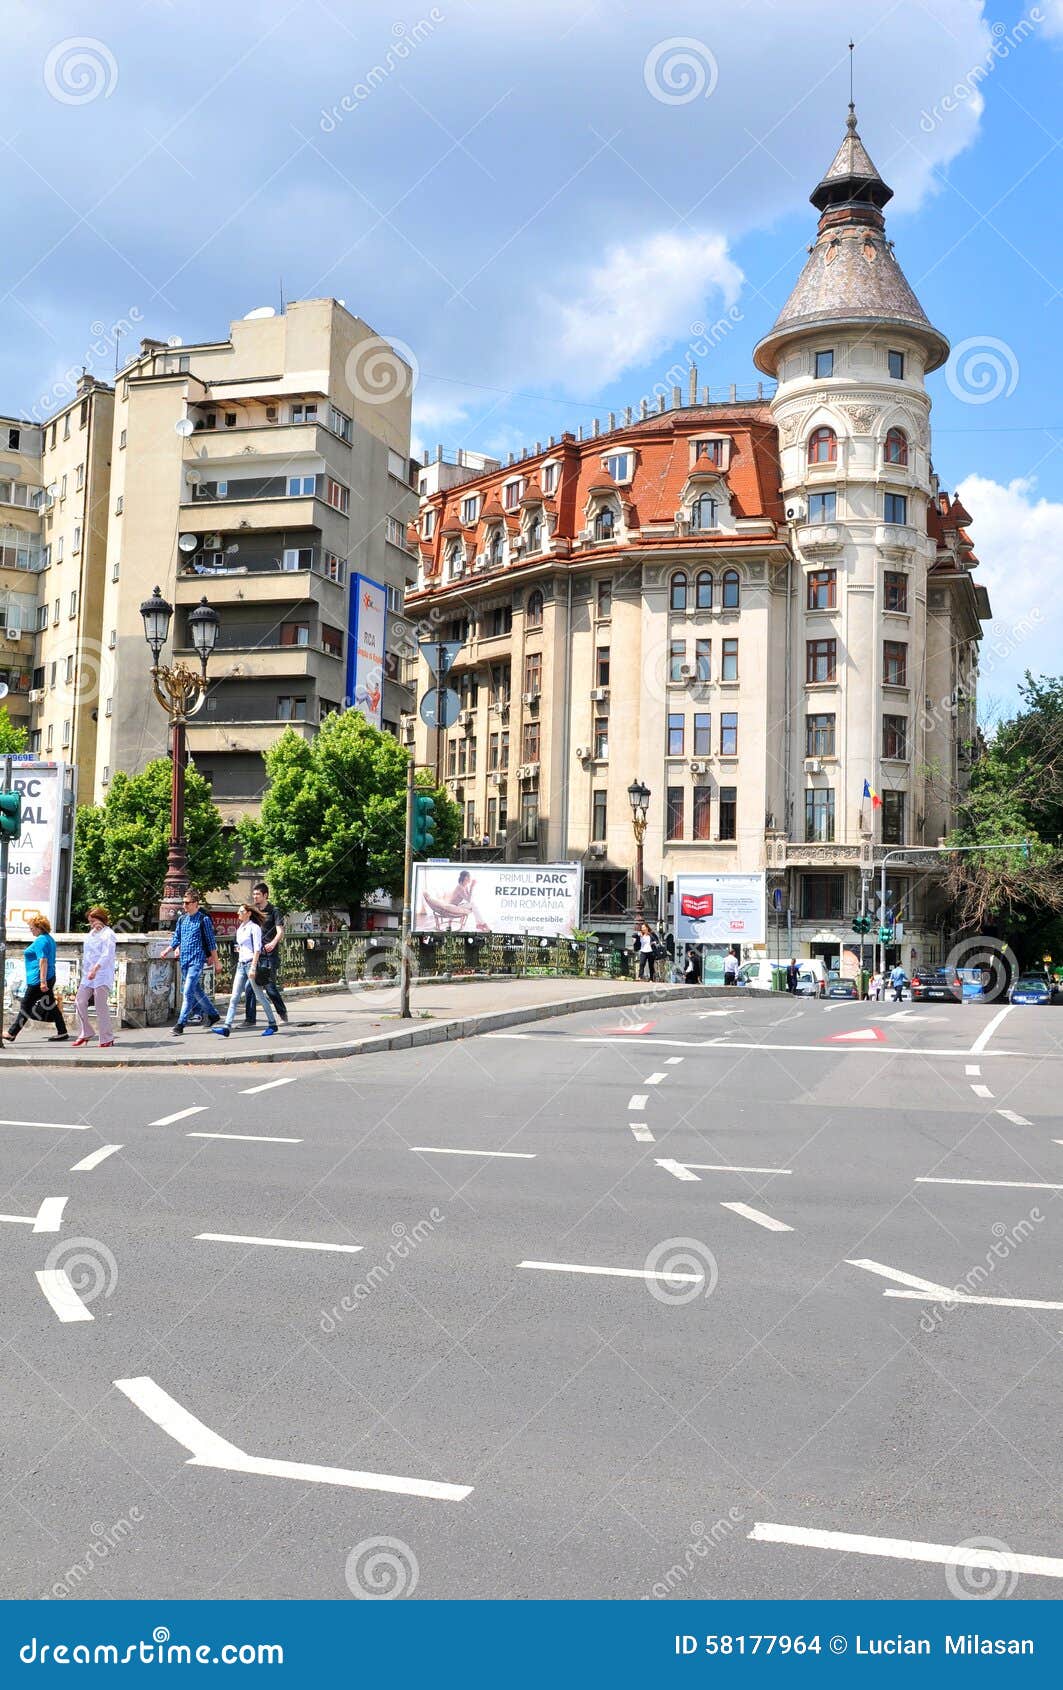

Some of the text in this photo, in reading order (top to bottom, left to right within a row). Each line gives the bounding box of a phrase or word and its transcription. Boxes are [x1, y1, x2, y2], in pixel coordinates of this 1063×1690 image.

[20, 806, 48, 824] AL
[8, 862, 31, 875] bile
[536, 873, 567, 884] PARC
